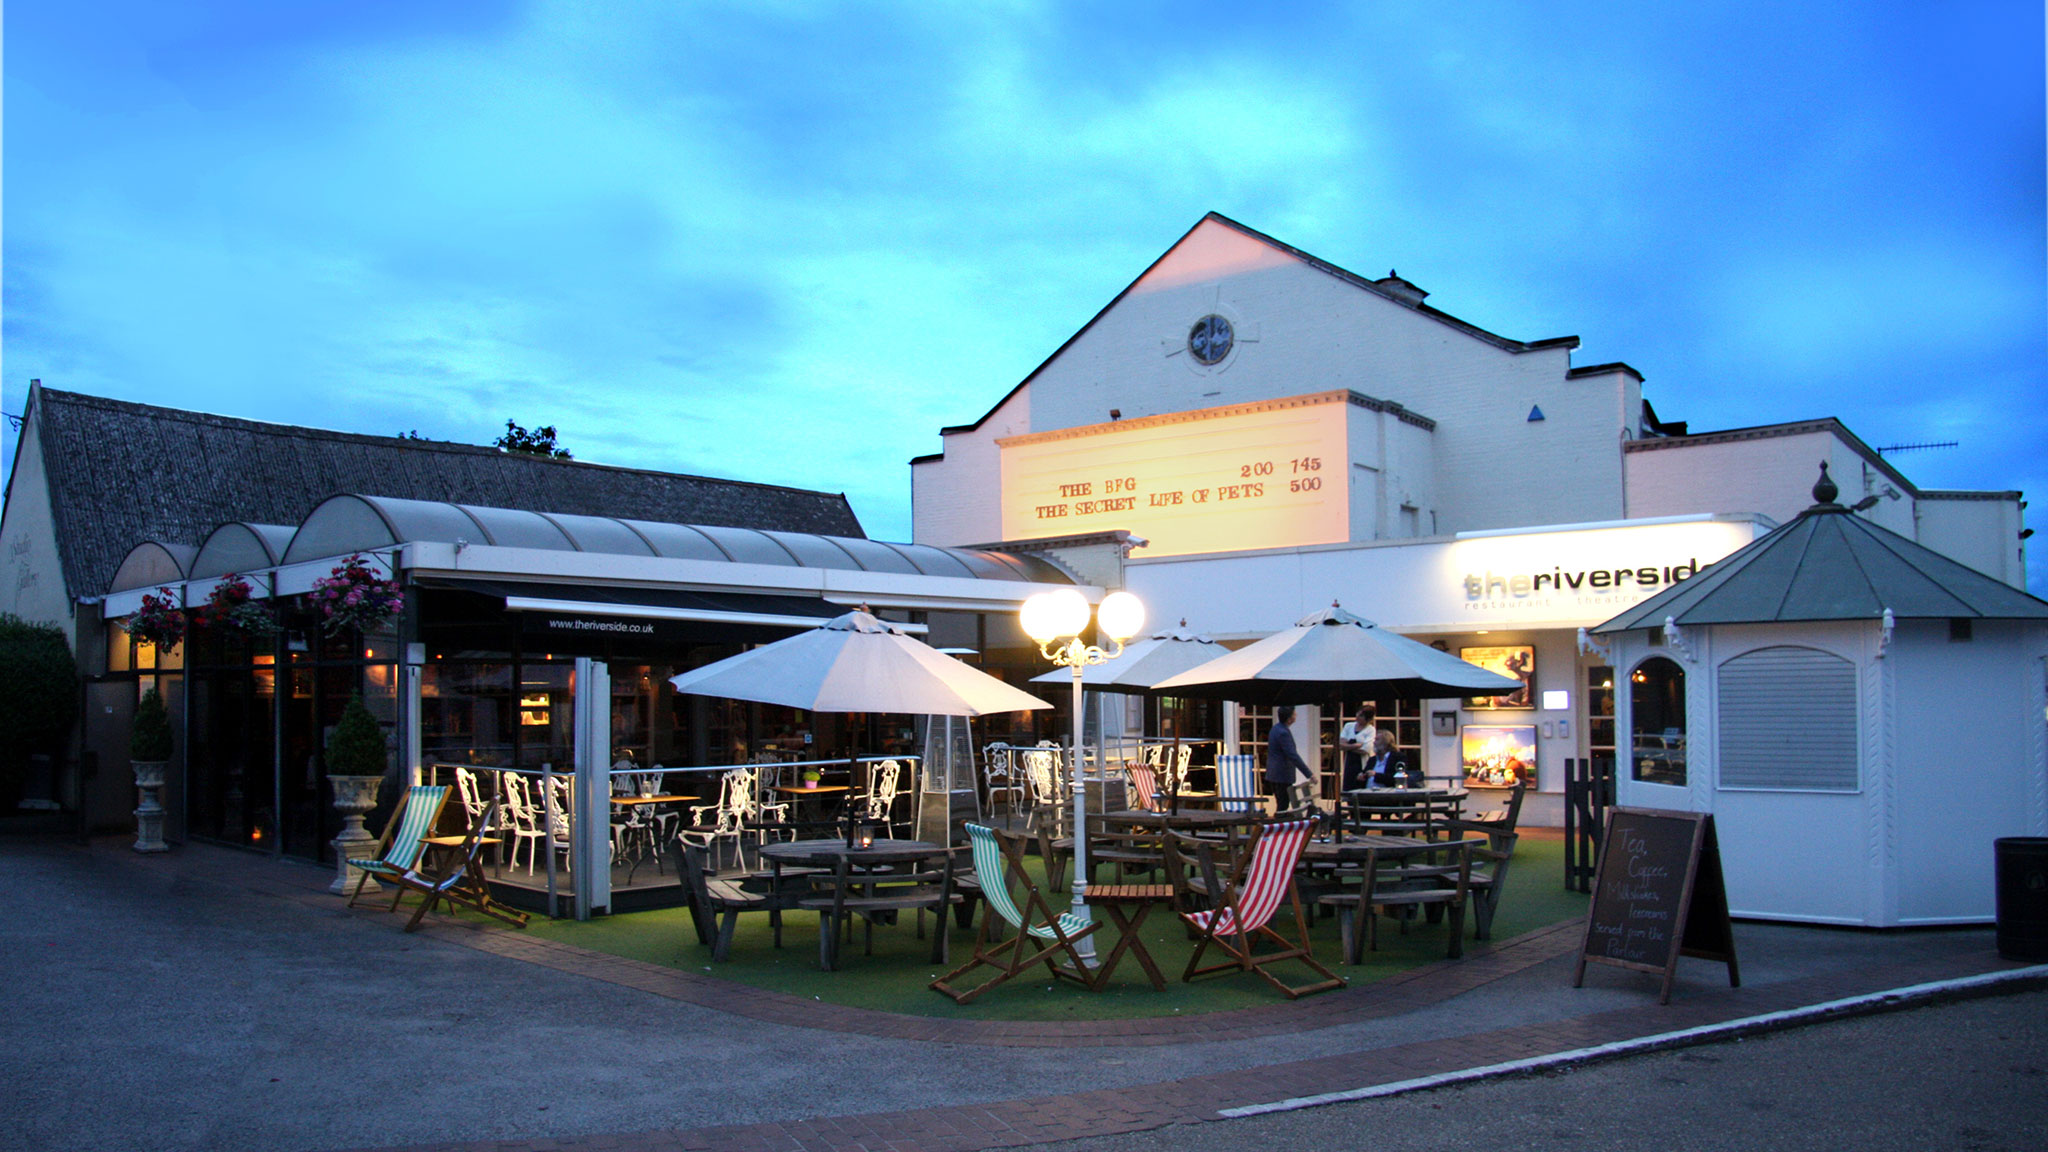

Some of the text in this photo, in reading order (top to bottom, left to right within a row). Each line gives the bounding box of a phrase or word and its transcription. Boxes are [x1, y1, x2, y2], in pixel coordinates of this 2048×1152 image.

[1059, 457, 1322, 498] THE BFG 200 745
[1036, 477, 1322, 519] THE SECRET LIFE OF PETS 500
[1464, 558, 1713, 596] theriversid
[1465, 596, 1639, 610] restaurant theatre
[550, 619, 654, 634] www.theriverside.co.uk
[1617, 828, 1647, 854] Tea,
